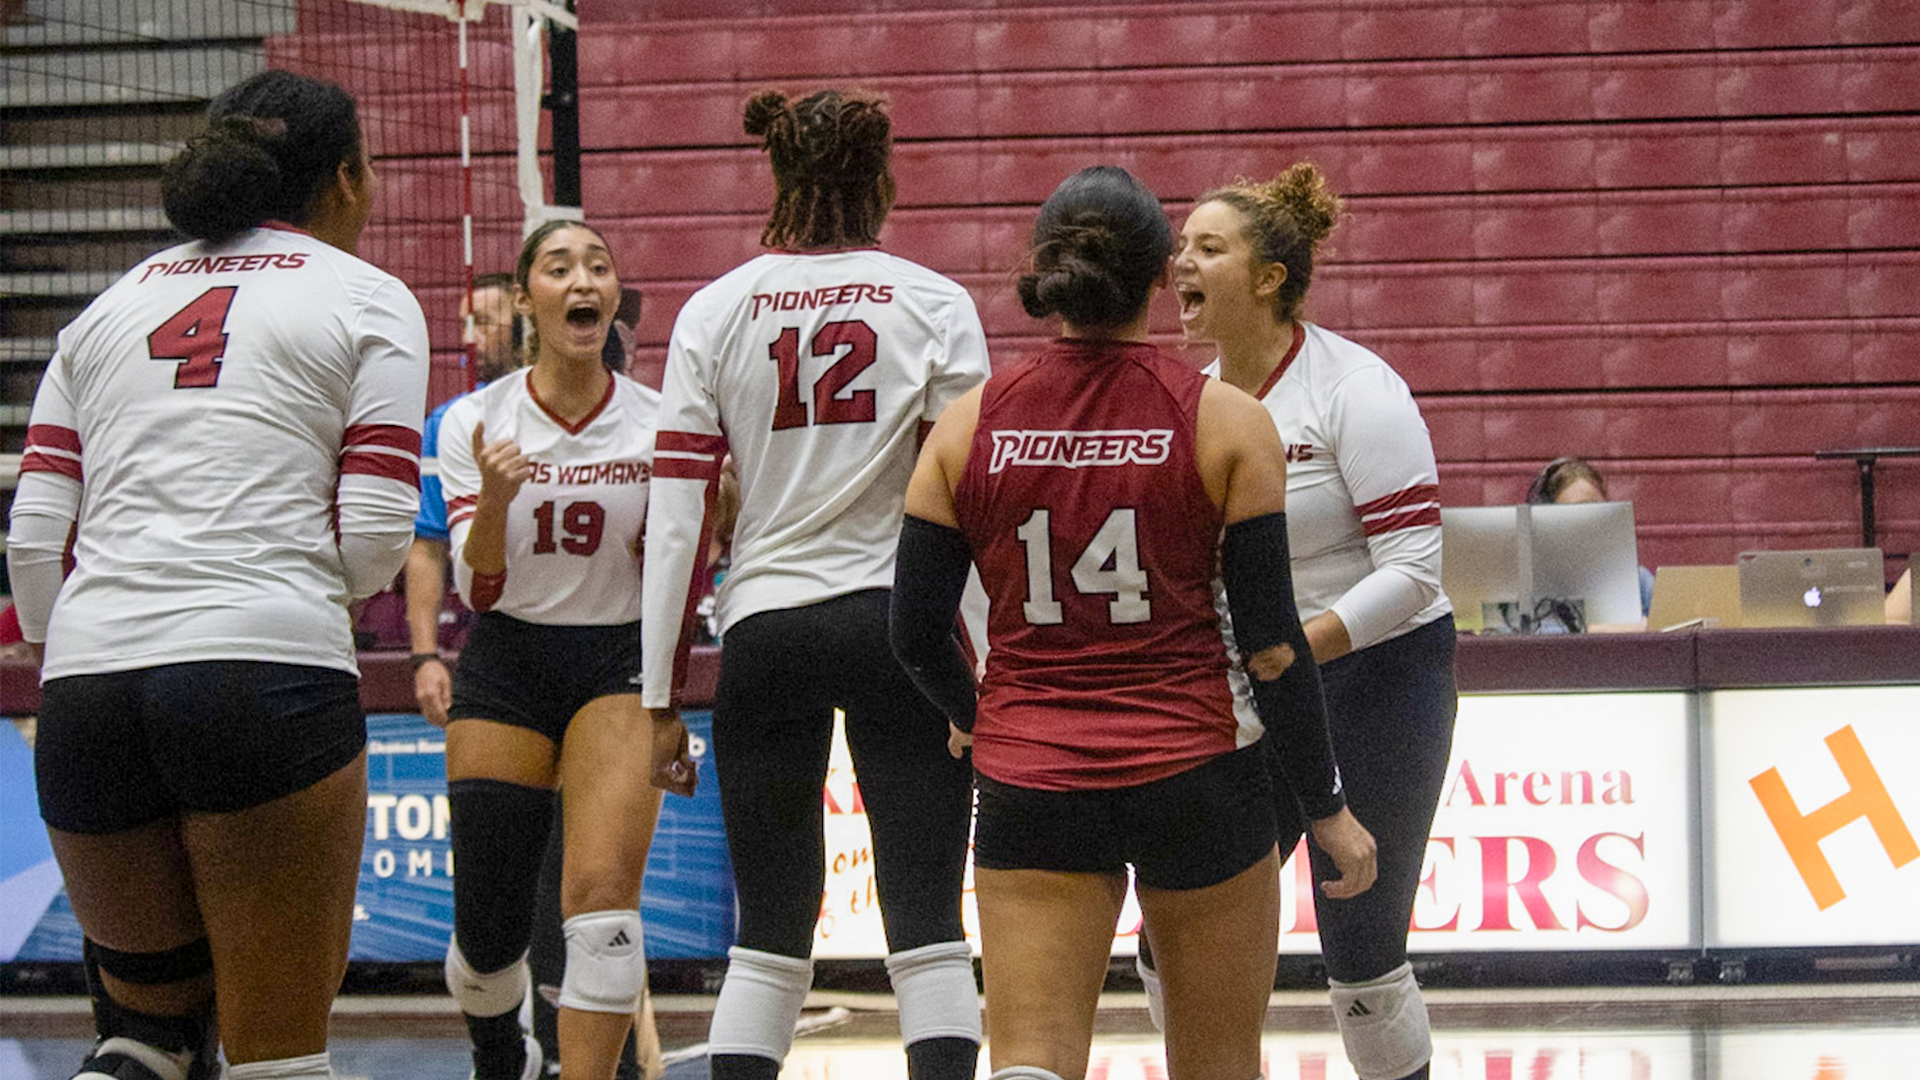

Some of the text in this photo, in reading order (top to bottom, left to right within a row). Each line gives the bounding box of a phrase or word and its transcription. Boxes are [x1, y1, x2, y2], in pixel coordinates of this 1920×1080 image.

[138, 252, 311, 284] PIONEERS
[751, 283, 895, 321] PIONEERS
[148, 285, 238, 390] 4
[768, 319, 879, 431] 12
[988, 429, 1175, 475] PIONEERS
[533, 501, 606, 556] 19
[1018, 507, 1152, 626] 14
[1446, 758, 1636, 807] Arena
